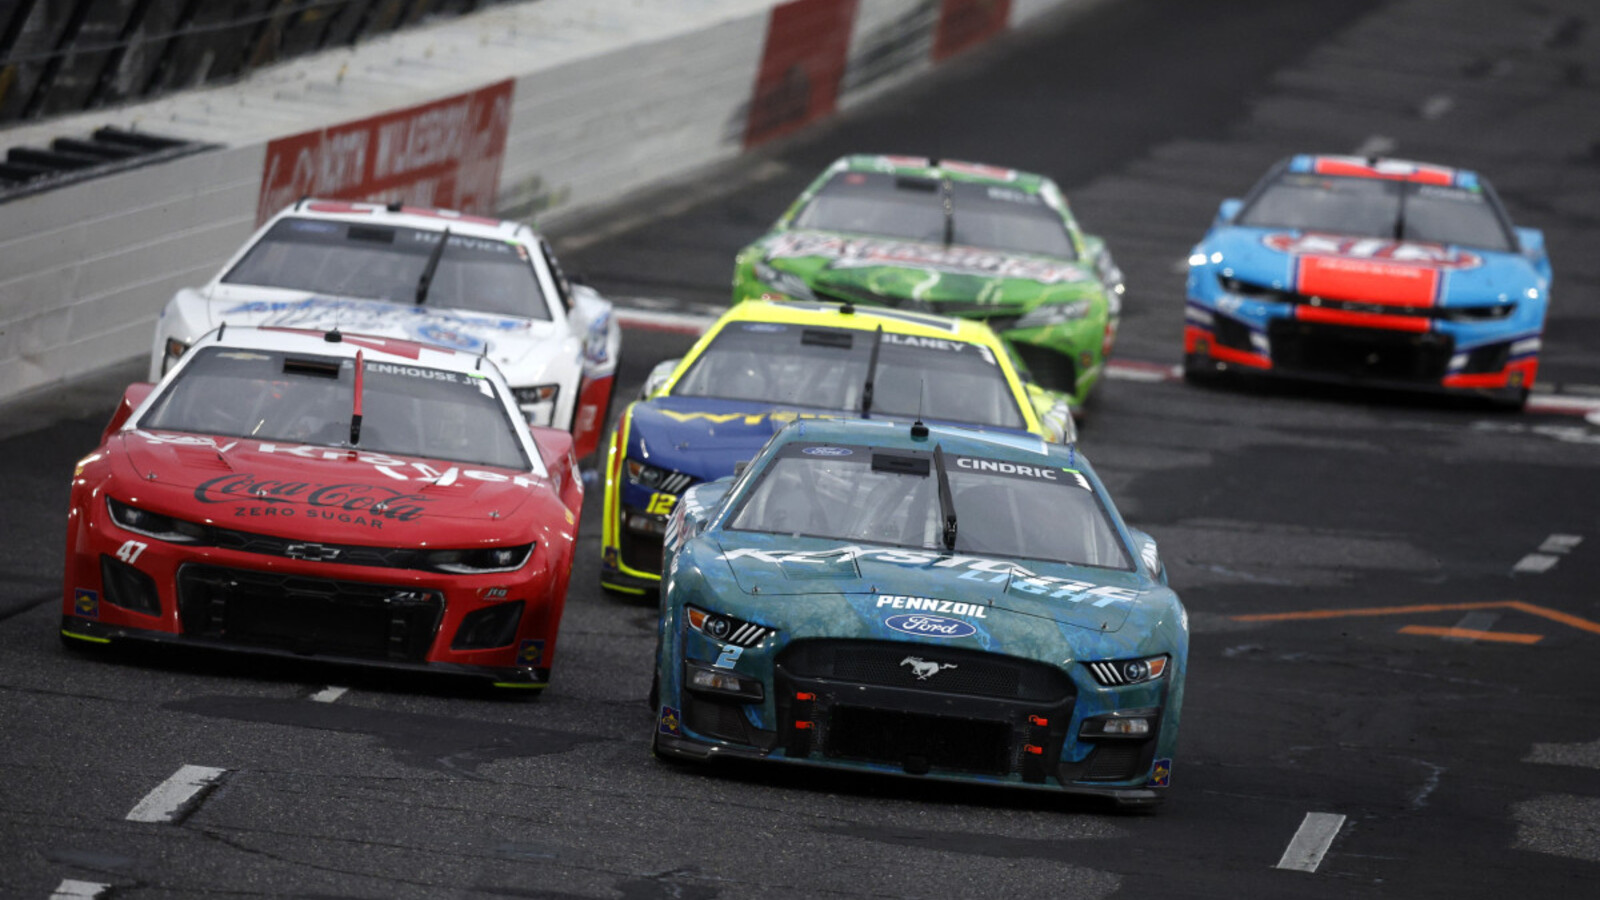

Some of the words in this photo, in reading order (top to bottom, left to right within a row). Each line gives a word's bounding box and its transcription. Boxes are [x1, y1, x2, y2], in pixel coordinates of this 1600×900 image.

[342, 359, 458, 383] SENHOUSE
[956, 457, 1057, 481] CINDRIC
[646, 492, 677, 514] 12
[234, 506, 295, 517] ZERO
[306, 508, 384, 530] SUGAR
[116, 539, 148, 564] 47
[957, 569, 1132, 609] LIGHT
[876, 594, 987, 619] PENNZOIL
[715, 644, 744, 669] 2
